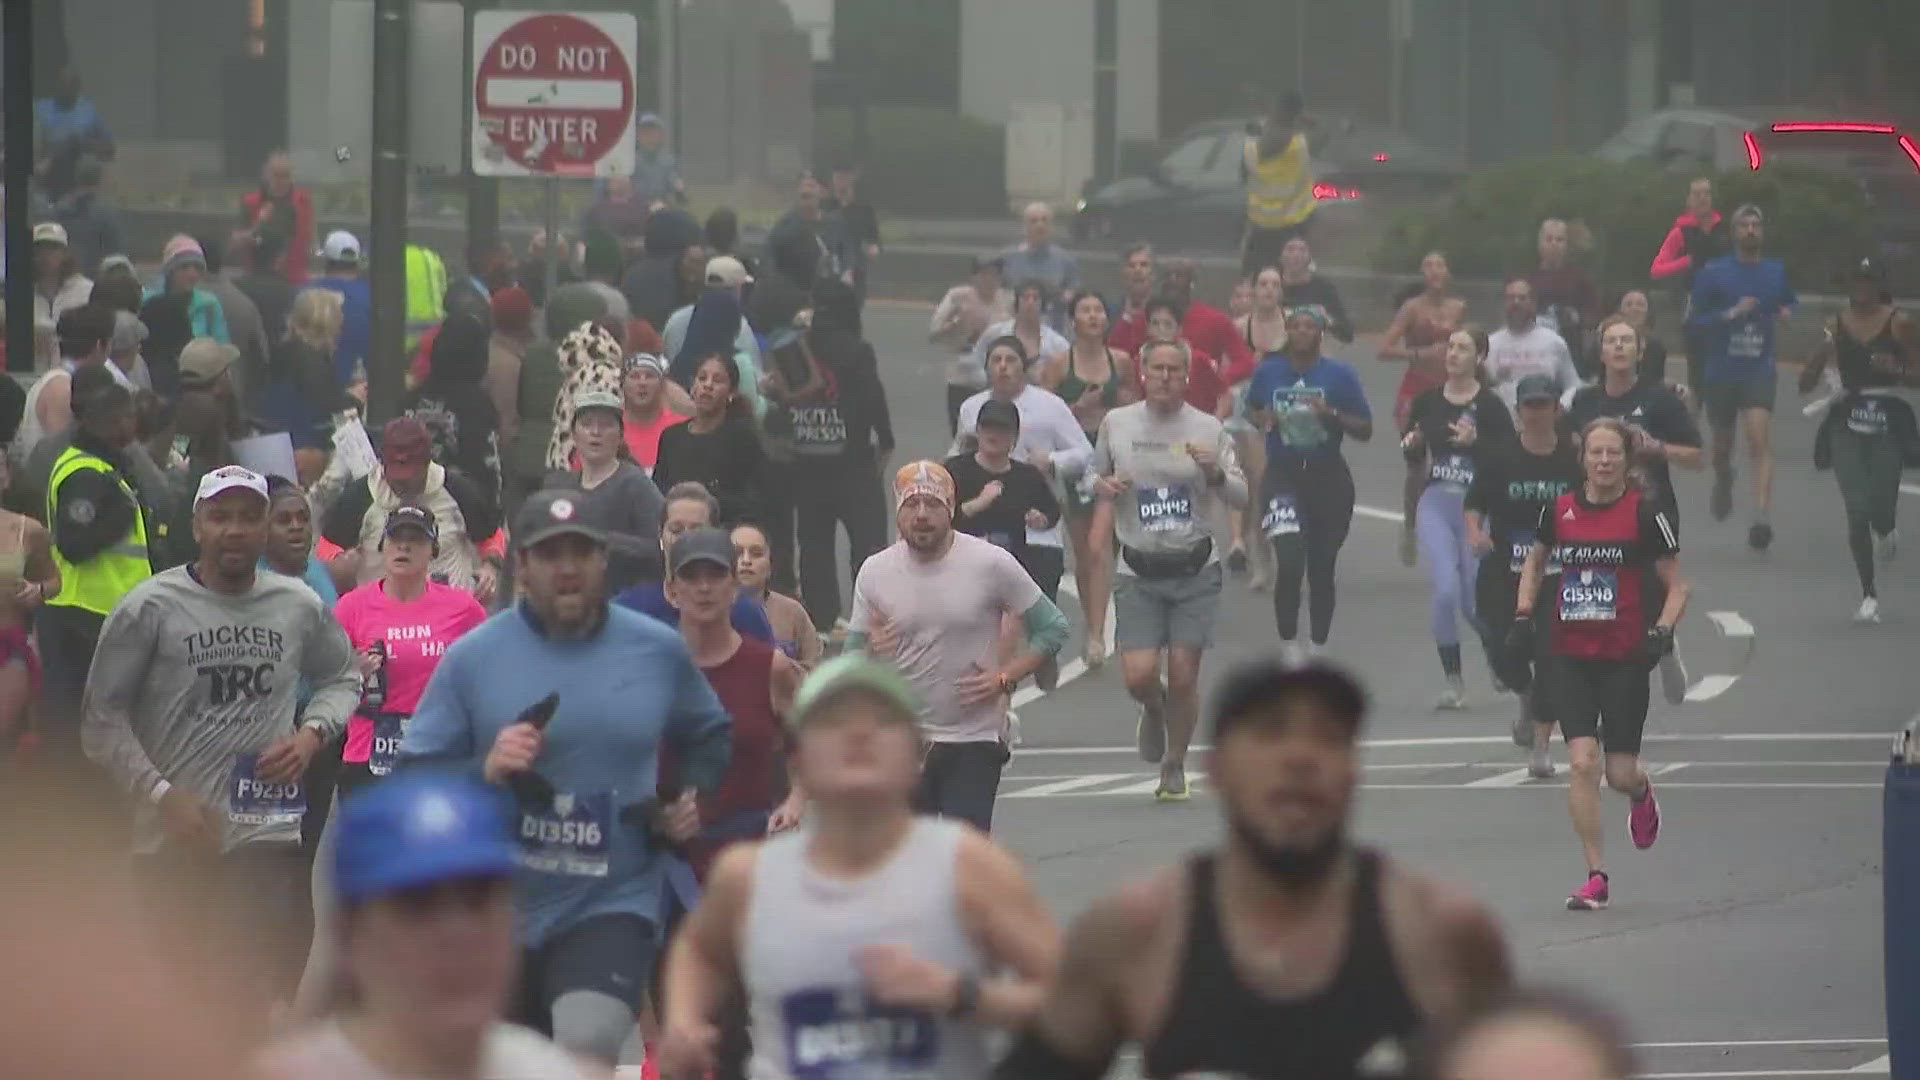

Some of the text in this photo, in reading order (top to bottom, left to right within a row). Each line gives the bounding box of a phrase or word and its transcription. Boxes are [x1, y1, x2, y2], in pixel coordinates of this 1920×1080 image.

[500, 44, 610, 72] DO NOT
[510, 115, 598, 144] ENTER
[1576, 546, 1623, 560] ATLANTA
[1562, 587, 1614, 602] C15548
[183, 625, 284, 655] TUCKER
[387, 624, 432, 641] RUN
[187, 646, 282, 666] RUNNING CLUB
[421, 640, 447, 657] HA
[197, 663, 275, 706] TRC
[522, 815, 602, 846] D13516
